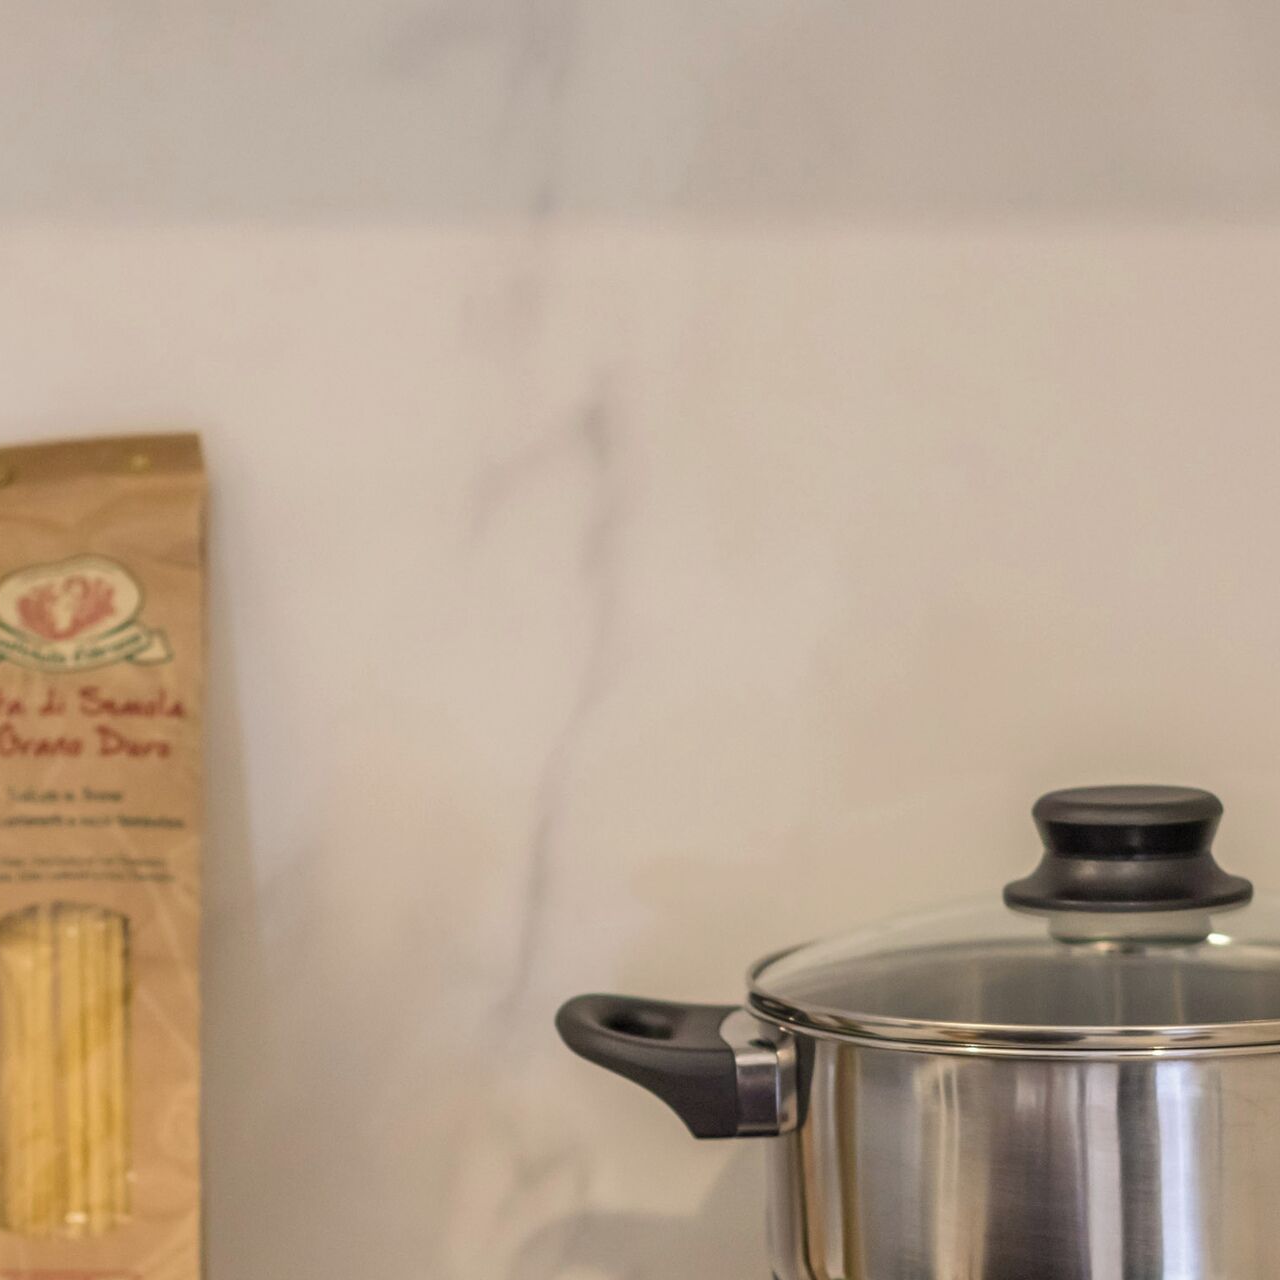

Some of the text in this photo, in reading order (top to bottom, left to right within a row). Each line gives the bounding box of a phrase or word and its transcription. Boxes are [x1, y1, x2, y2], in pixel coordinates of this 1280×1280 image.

[38, 688, 65, 716] di
[79, 686, 186, 718] Semola
[95, 725, 171, 758] Duro
